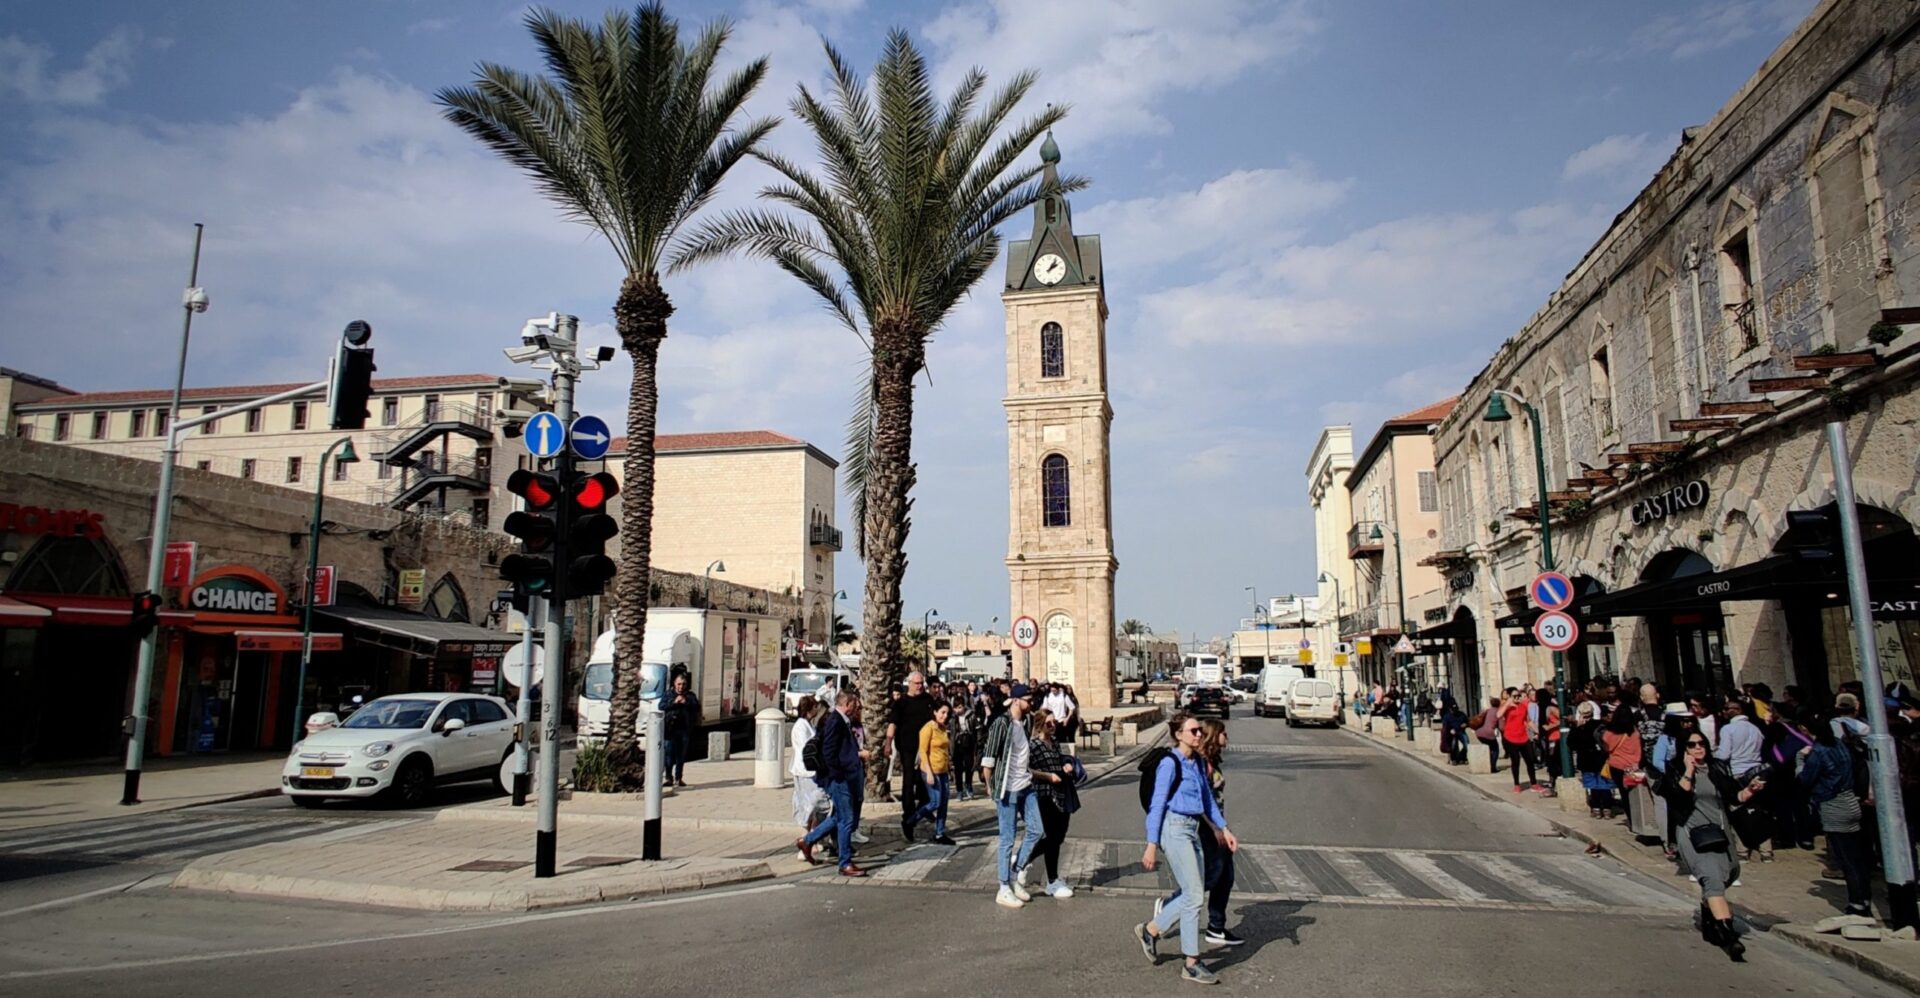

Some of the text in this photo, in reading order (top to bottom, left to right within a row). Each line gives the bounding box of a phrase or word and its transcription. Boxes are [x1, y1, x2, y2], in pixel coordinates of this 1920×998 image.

[1631, 480, 1704, 526] CASTRO
[1697, 580, 1731, 596] CASTRO
[192, 586, 278, 612] CHANGE
[1018, 626, 1033, 639] 30
[1545, 625, 1567, 638] 30
[545, 729, 556, 741] 12
